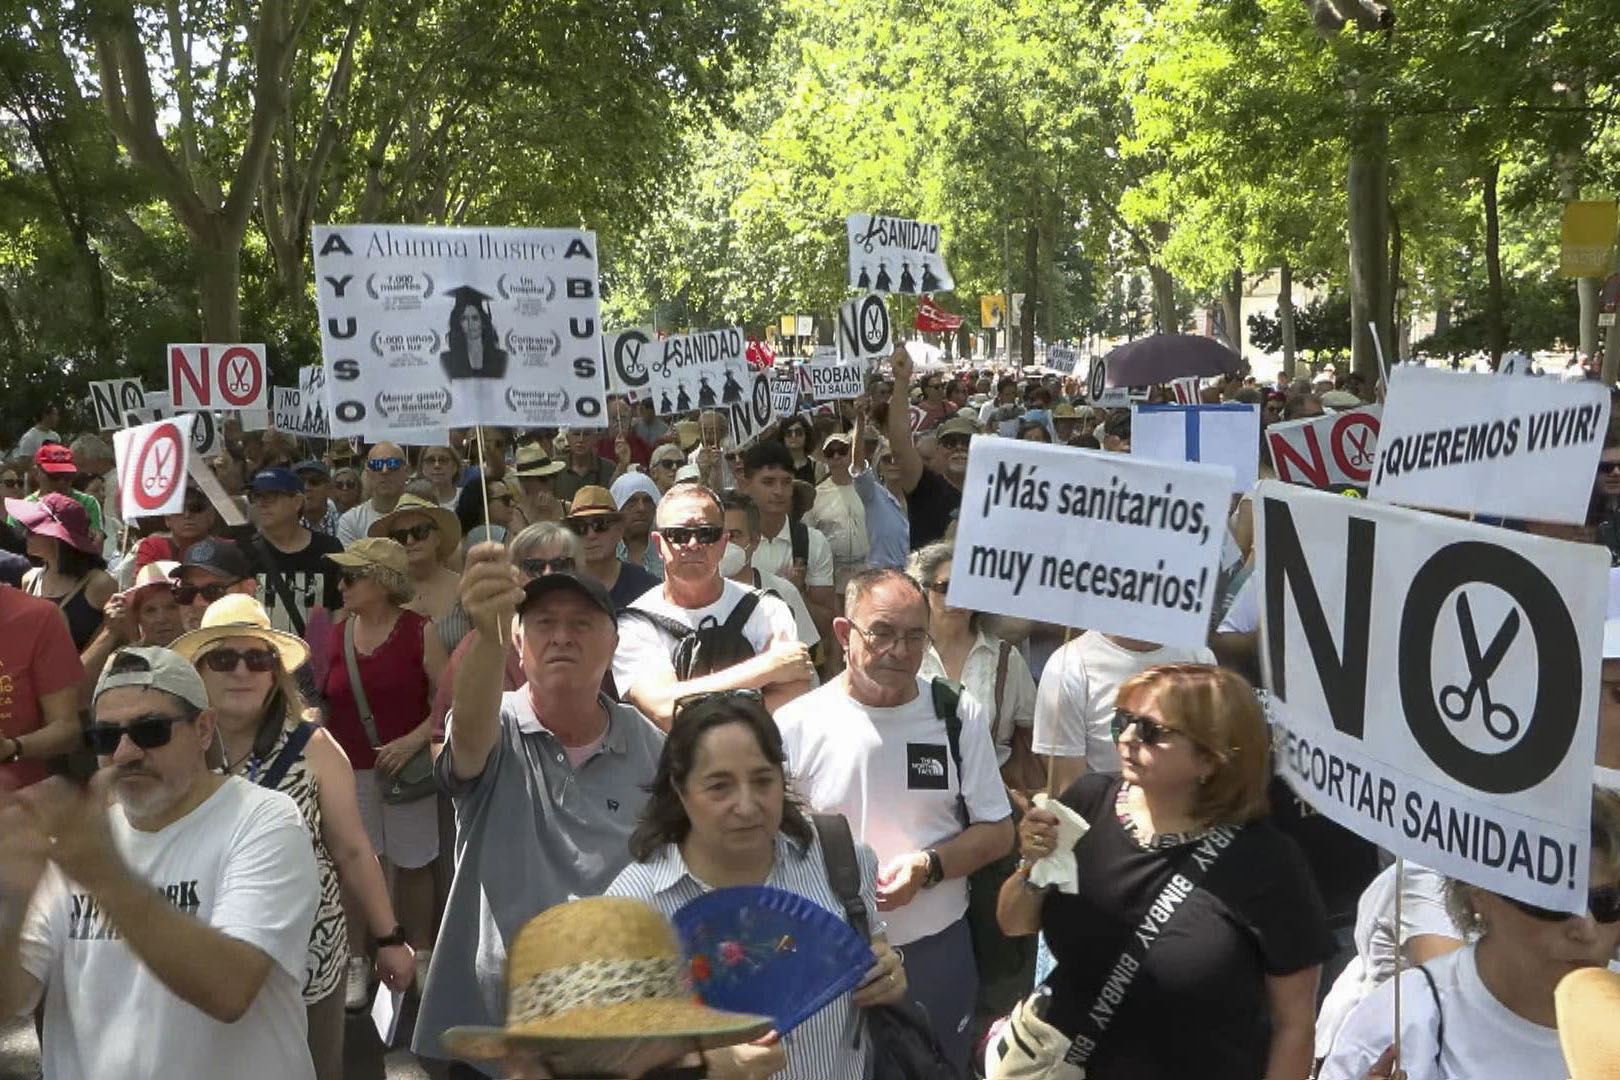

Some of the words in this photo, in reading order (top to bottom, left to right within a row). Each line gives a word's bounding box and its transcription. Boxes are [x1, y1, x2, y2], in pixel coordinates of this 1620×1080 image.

[367, 231, 468, 259] Alumna
[879, 219, 938, 254] SANIDAD
[672, 330, 741, 368] SANIDAD
[838, 295, 889, 361] NO
[172, 347, 263, 407] NO
[731, 374, 771, 447] NO
[812, 367, 861, 385] ROBAN
[1376, 419, 1522, 487] ¡QUEREMOS
[1527, 403, 1602, 455] VIVIR!
[982, 461, 1051, 518] ¡Más
[1057, 476, 1211, 545] sanitarios,
[969, 544, 1033, 597] muy
[1039, 546, 1209, 613] necesarios!
[1262, 497, 1583, 795] NO
[1402, 791, 1578, 891] SANIDAD!
[1135, 873, 1195, 950] BIMBAY
